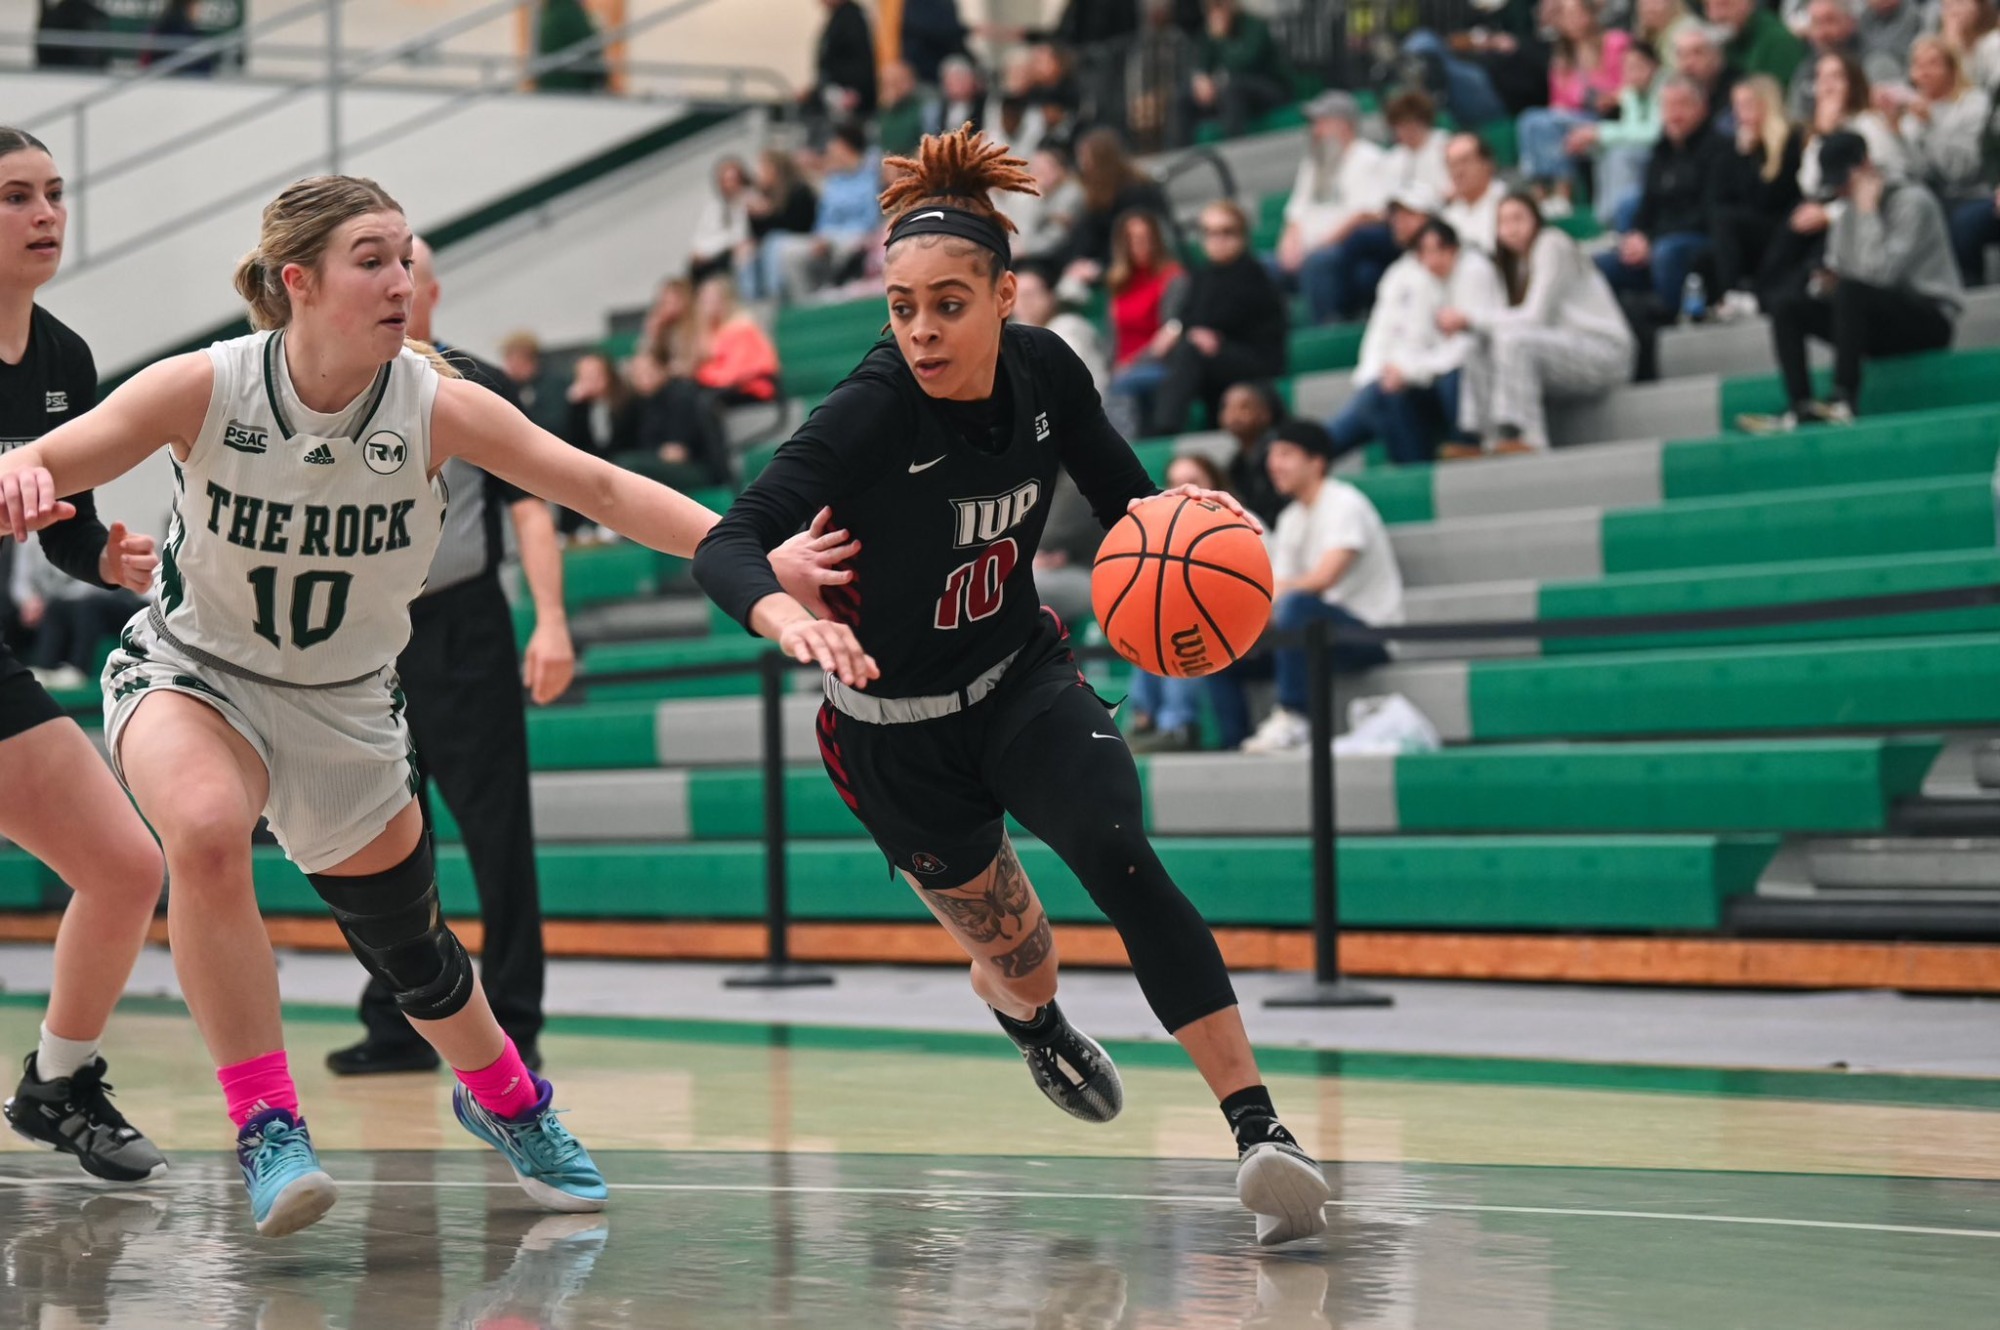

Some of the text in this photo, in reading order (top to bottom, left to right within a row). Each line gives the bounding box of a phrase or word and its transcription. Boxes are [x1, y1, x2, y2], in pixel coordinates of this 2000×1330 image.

[46, 396, 68, 407] PSC
[225, 426, 268, 448] PSAC
[304, 455, 335, 465] adidas
[206, 479, 416, 557] THE ROCK
[954, 481, 1040, 547] IUP
[246, 565, 355, 650] 10
[934, 537, 1019, 629] 10
